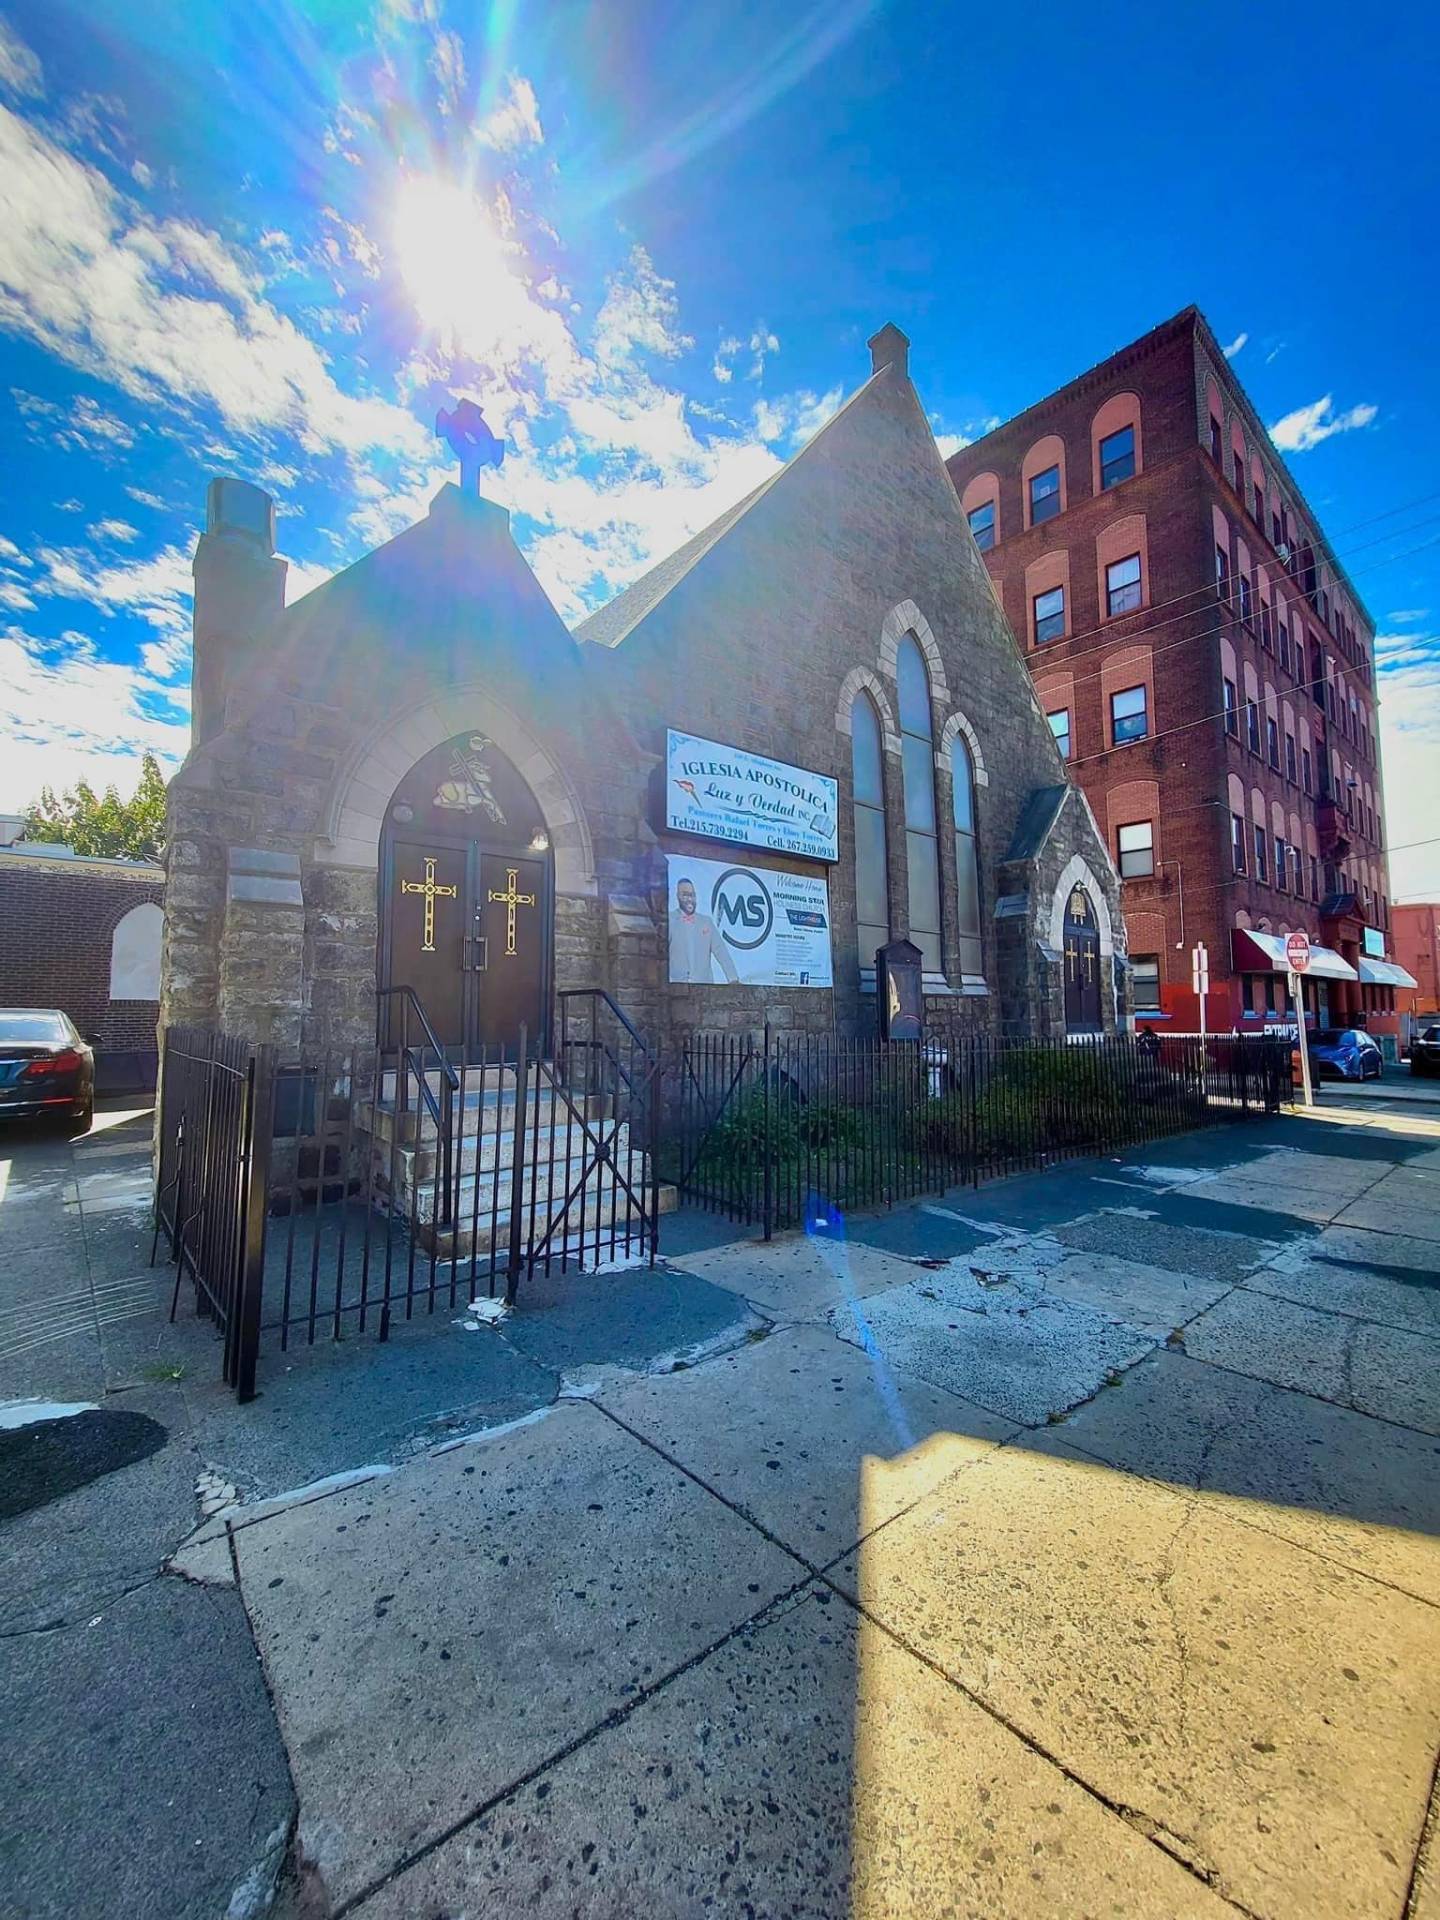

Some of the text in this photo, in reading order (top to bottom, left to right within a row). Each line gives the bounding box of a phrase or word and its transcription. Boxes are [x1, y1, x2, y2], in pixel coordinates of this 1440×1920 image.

[681, 761, 743, 780] IGLESIA
[745, 769, 828, 815] APOSTOLICA
[704, 782, 733, 802] Luz
[735, 794, 744, 808] y
[748, 793, 796, 818] Verdad
[717, 892, 766, 928] MS
[773, 891, 807, 903] MORNING
